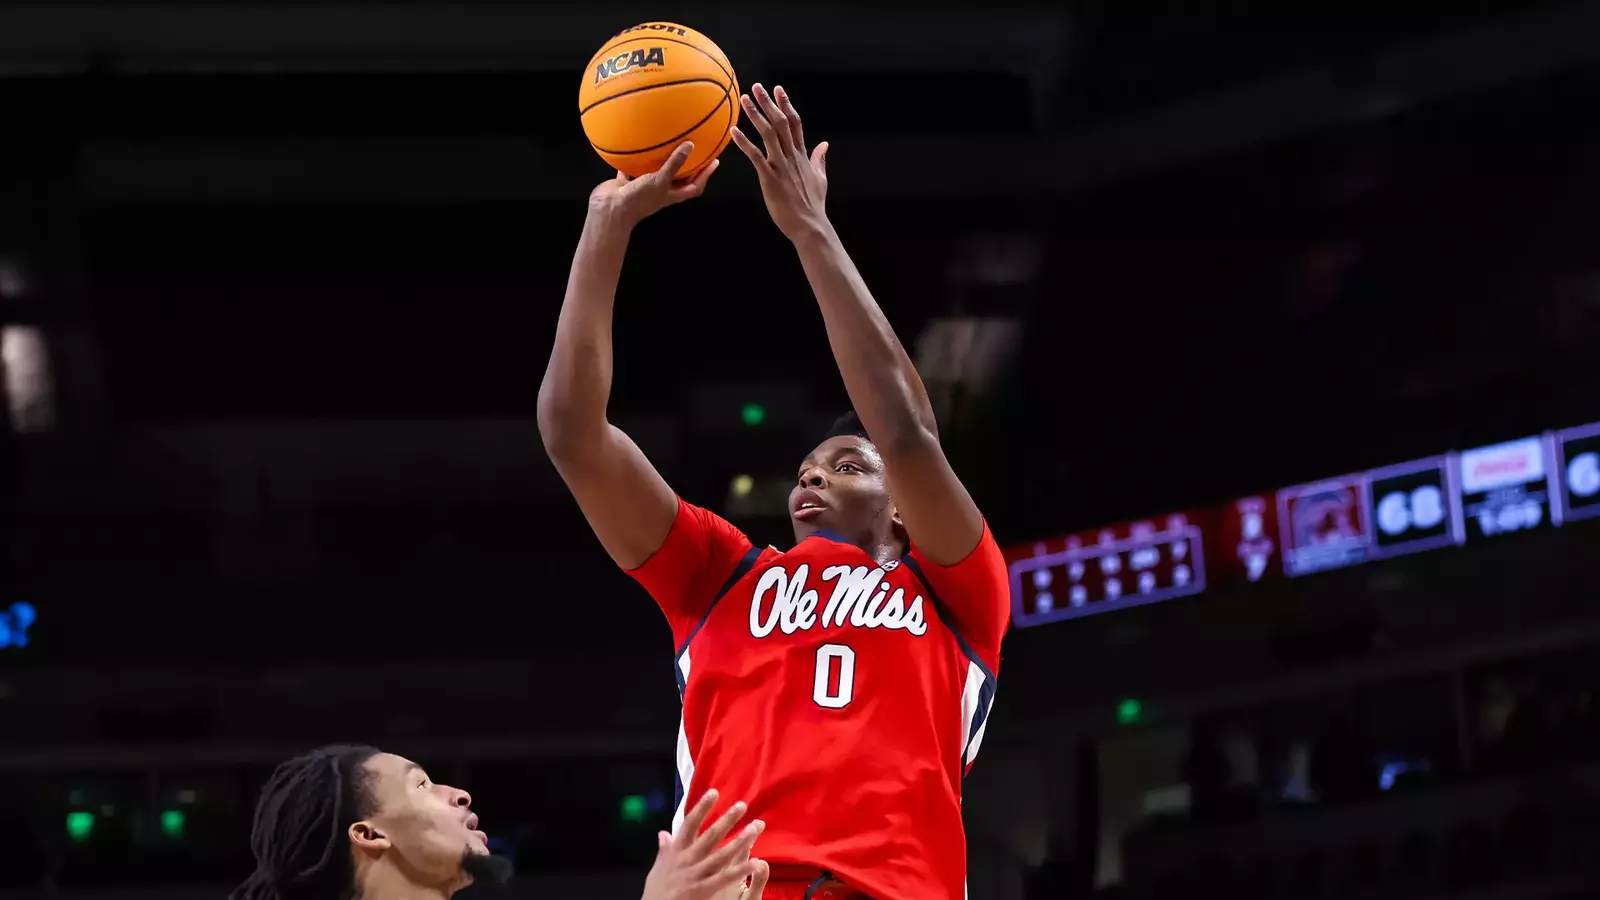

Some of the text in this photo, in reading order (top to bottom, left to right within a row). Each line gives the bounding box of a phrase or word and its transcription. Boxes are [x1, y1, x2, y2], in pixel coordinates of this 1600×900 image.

[594, 47, 665, 85] NCAA
[749, 563, 928, 639] Ole Miss
[812, 643, 856, 709] 0
